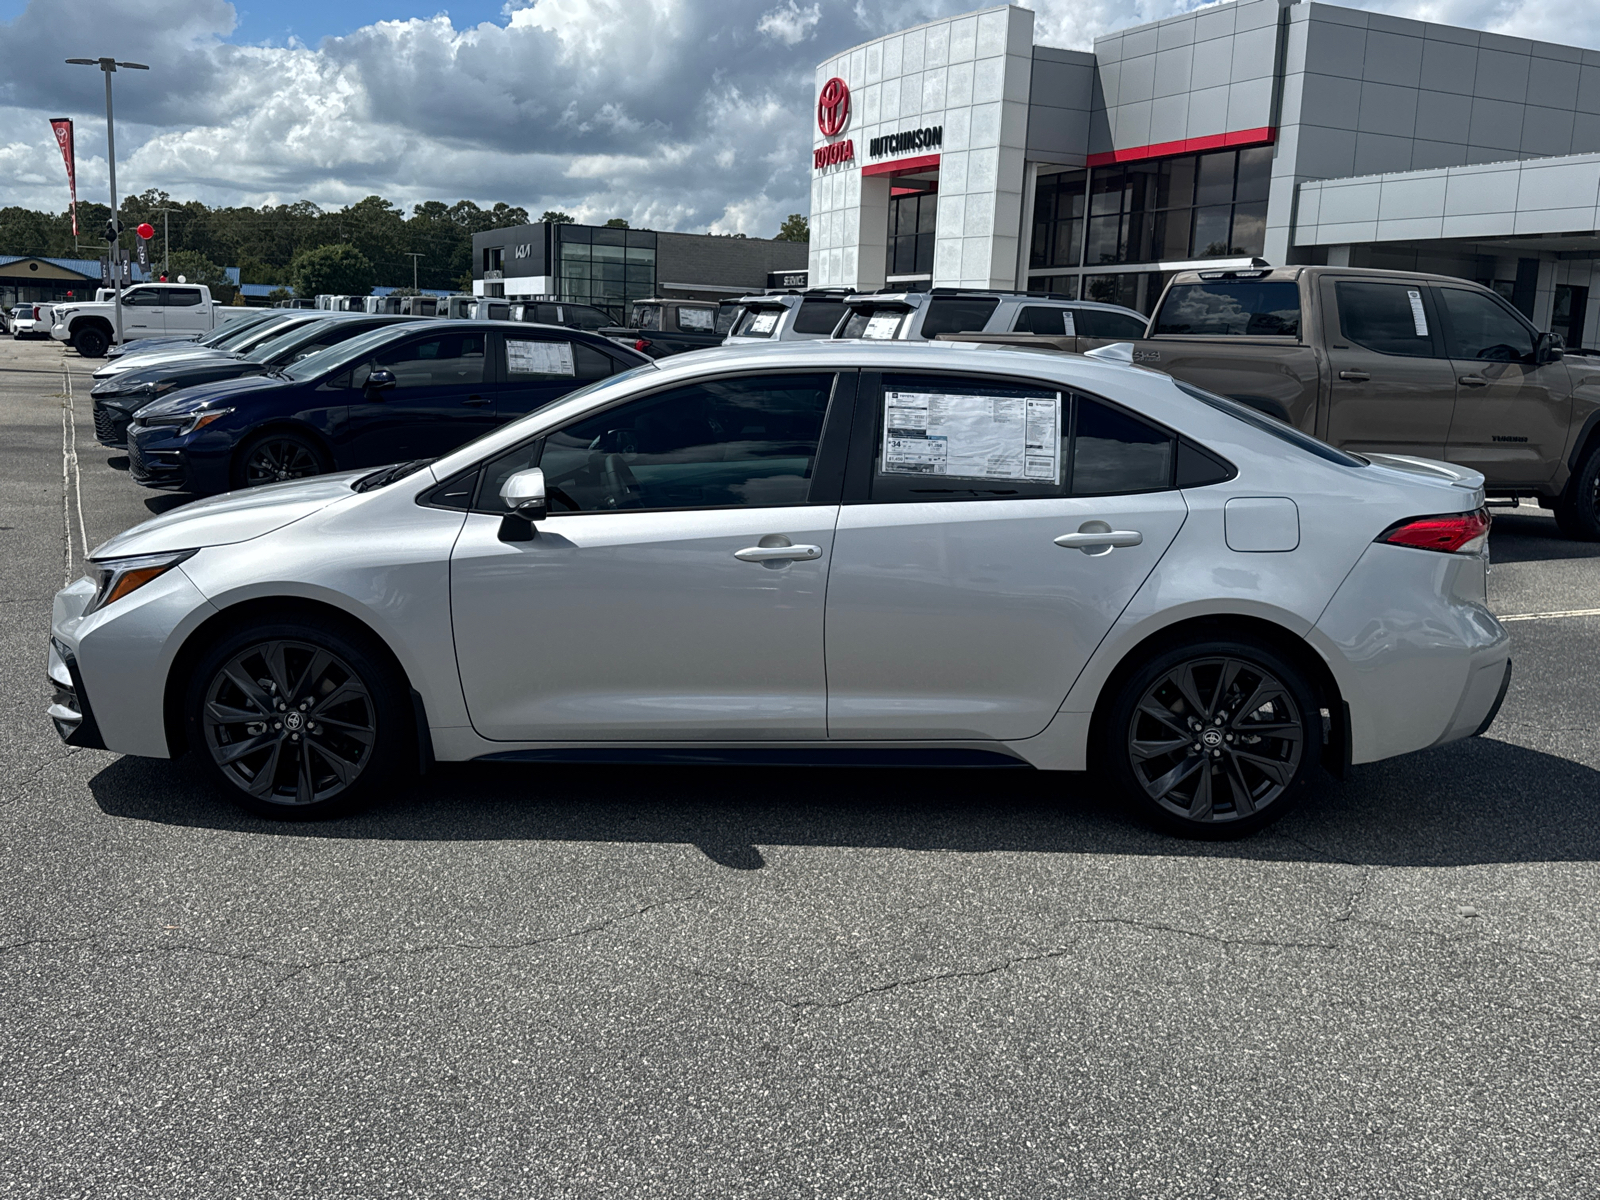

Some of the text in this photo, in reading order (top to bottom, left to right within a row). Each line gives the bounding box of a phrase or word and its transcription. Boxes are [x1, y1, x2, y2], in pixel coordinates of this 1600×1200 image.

[870, 125, 943, 157] HUTCHINSON
[813, 139, 854, 169] TOYOTA
[783, 275, 806, 286] SERVICE
[891, 440, 901, 448] 34
